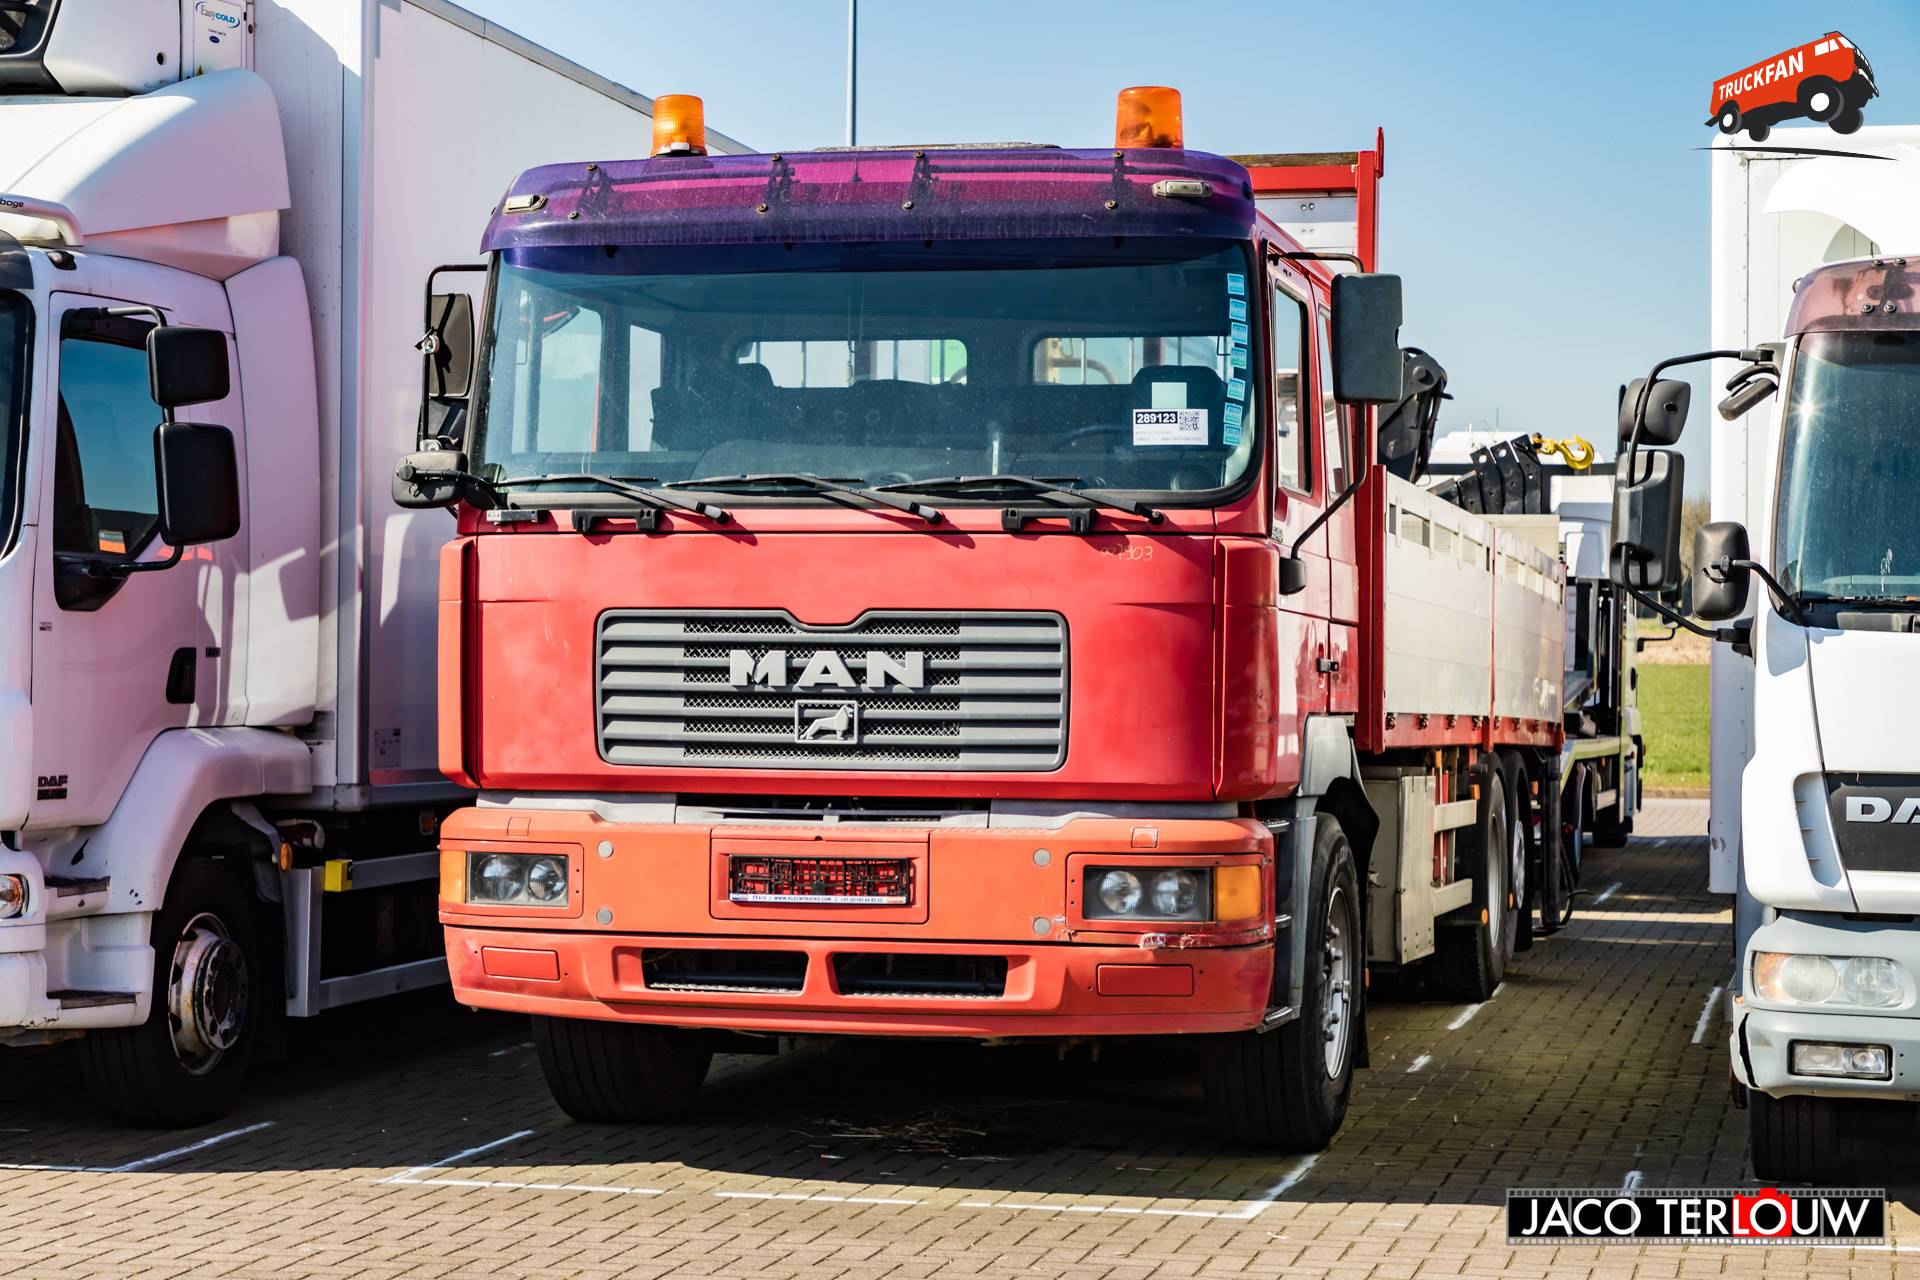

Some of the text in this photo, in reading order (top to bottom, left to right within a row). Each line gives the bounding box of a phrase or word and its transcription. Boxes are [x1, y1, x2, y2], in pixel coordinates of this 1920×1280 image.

[1136, 413, 1176, 424] 289123
[729, 650, 924, 689] MAN
[37, 775, 69, 788] DAF
